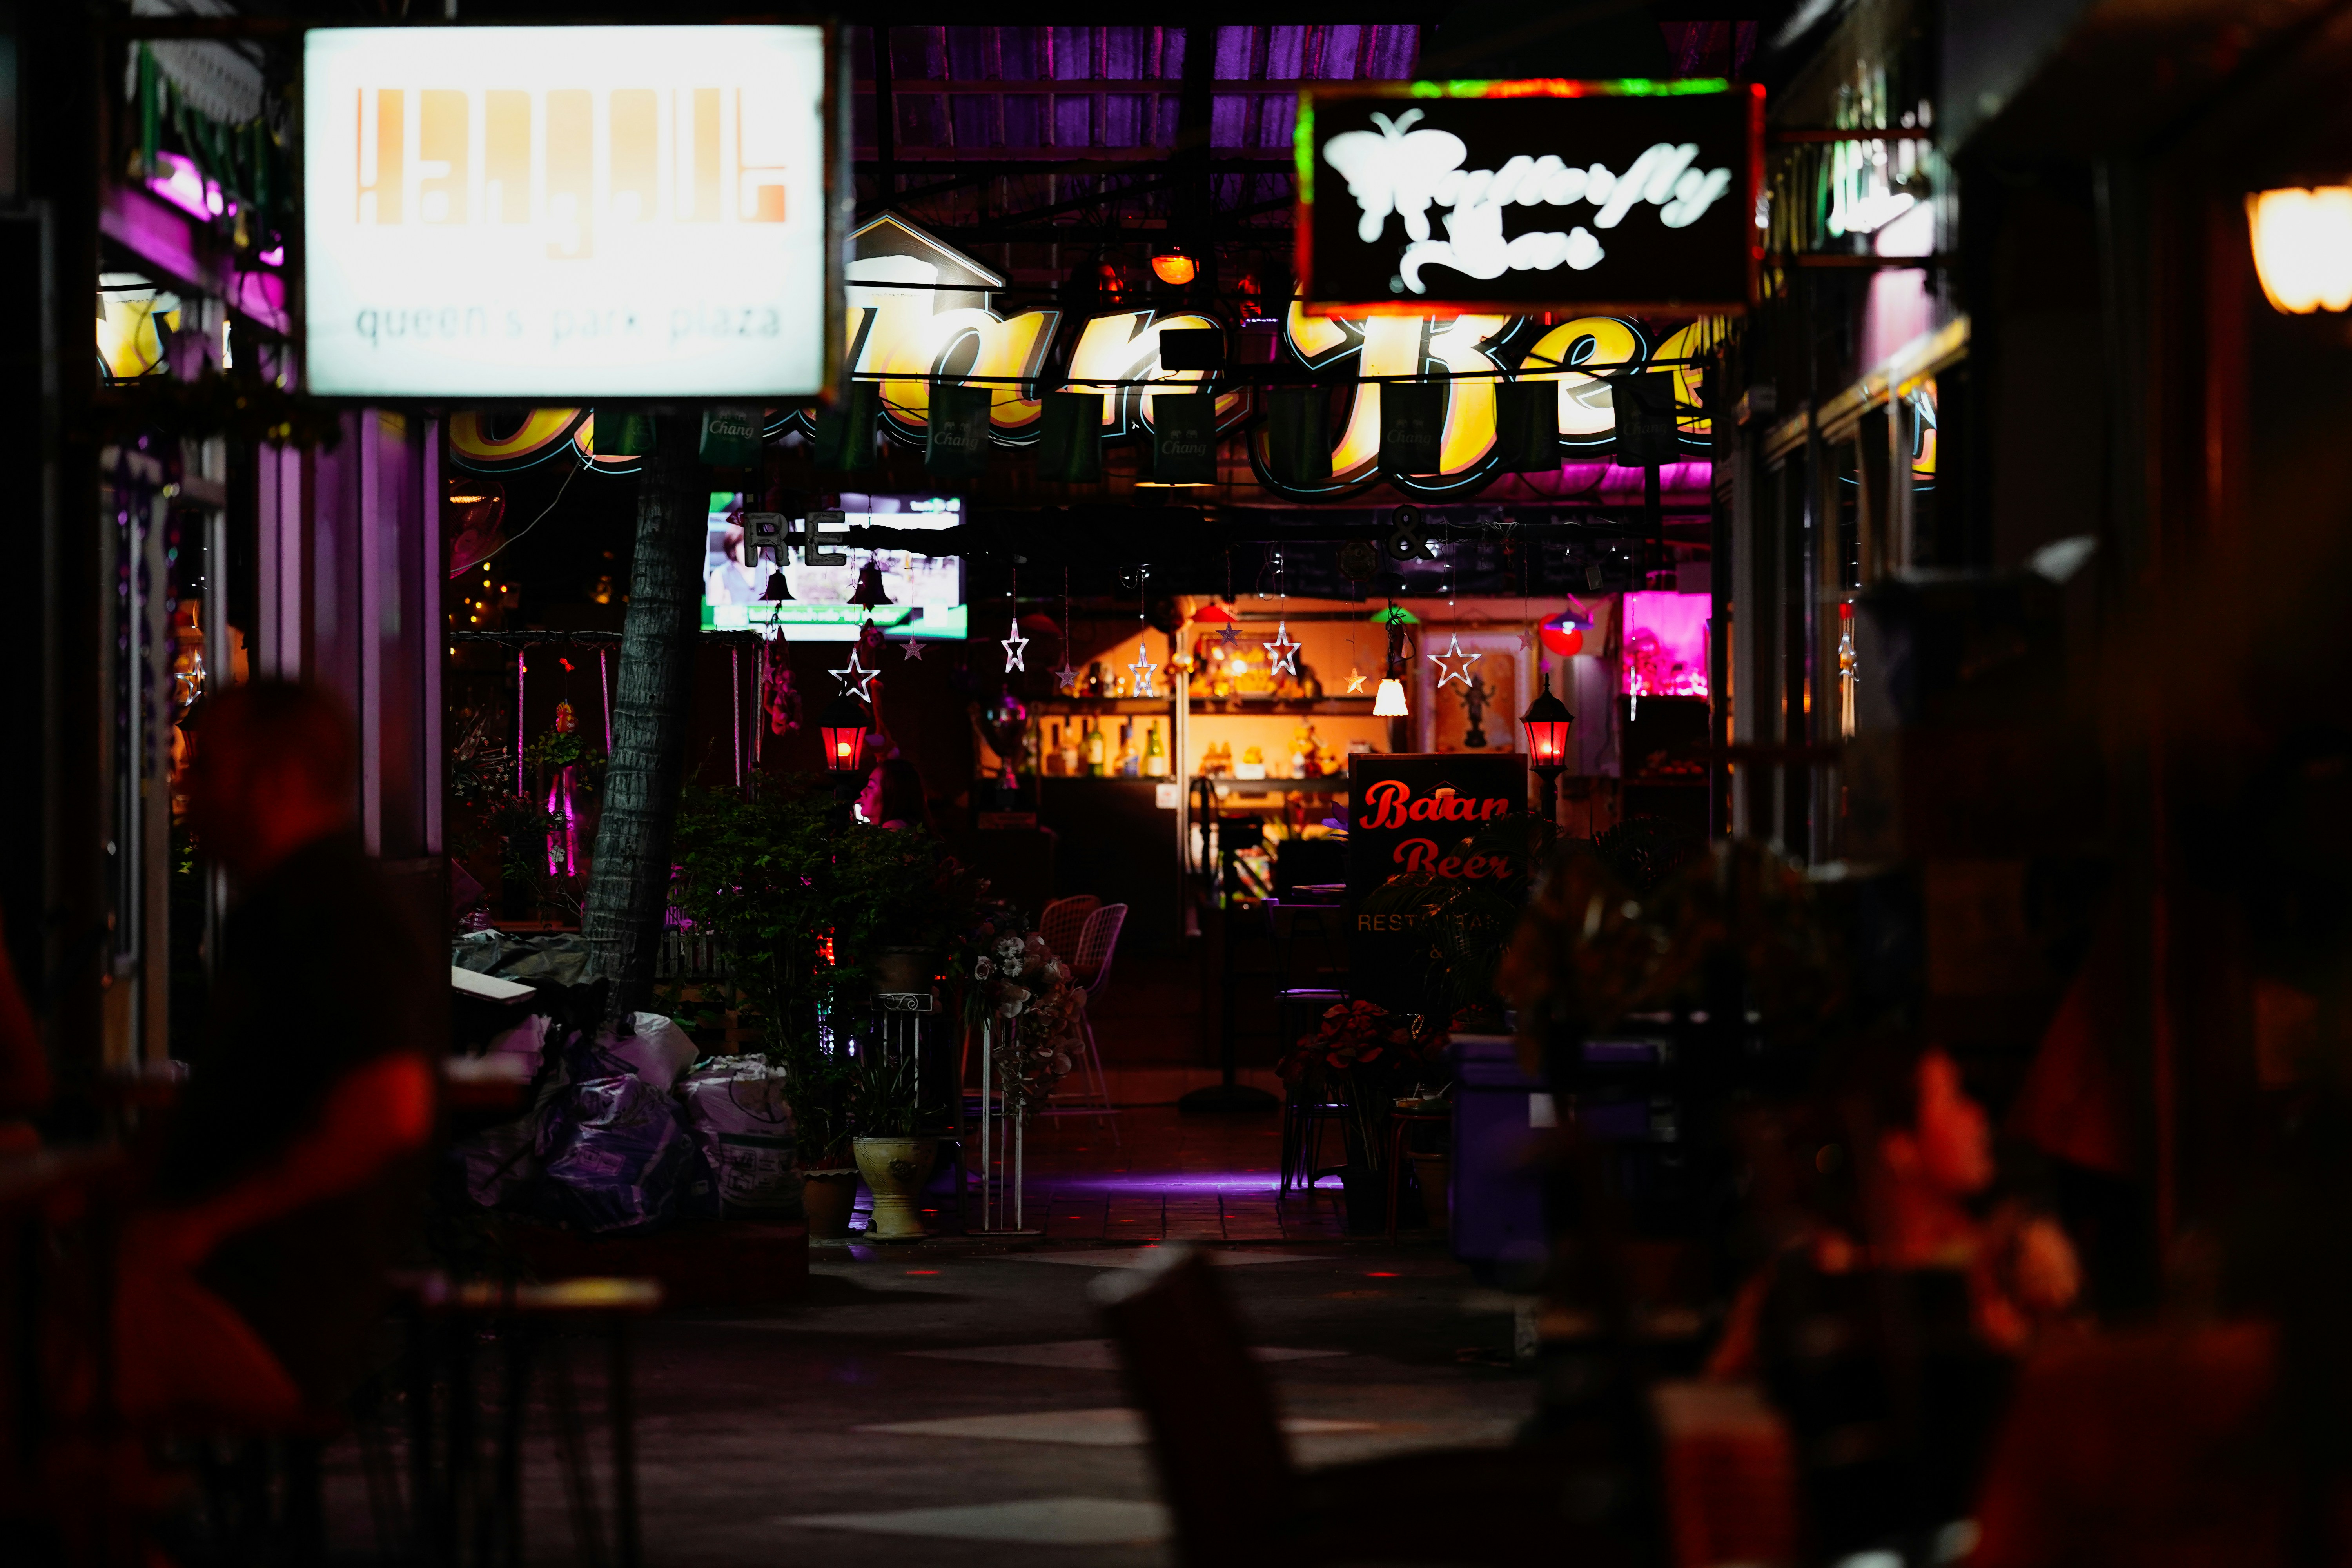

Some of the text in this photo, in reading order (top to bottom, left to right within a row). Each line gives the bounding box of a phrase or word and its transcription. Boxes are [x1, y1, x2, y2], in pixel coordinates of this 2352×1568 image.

[550, 303, 643, 352] park
[667, 299, 781, 354] plaza
[709, 420, 755, 440] Chang
[1387, 428, 1432, 447] Chang
[1623, 421, 1668, 436] Chang
[934, 431, 979, 451] Chang
[1161, 440, 1207, 457] Chang
[1387, 505, 1435, 560] &
[1359, 780, 1509, 829] Baan
[1386, 837, 1514, 886] Beer
